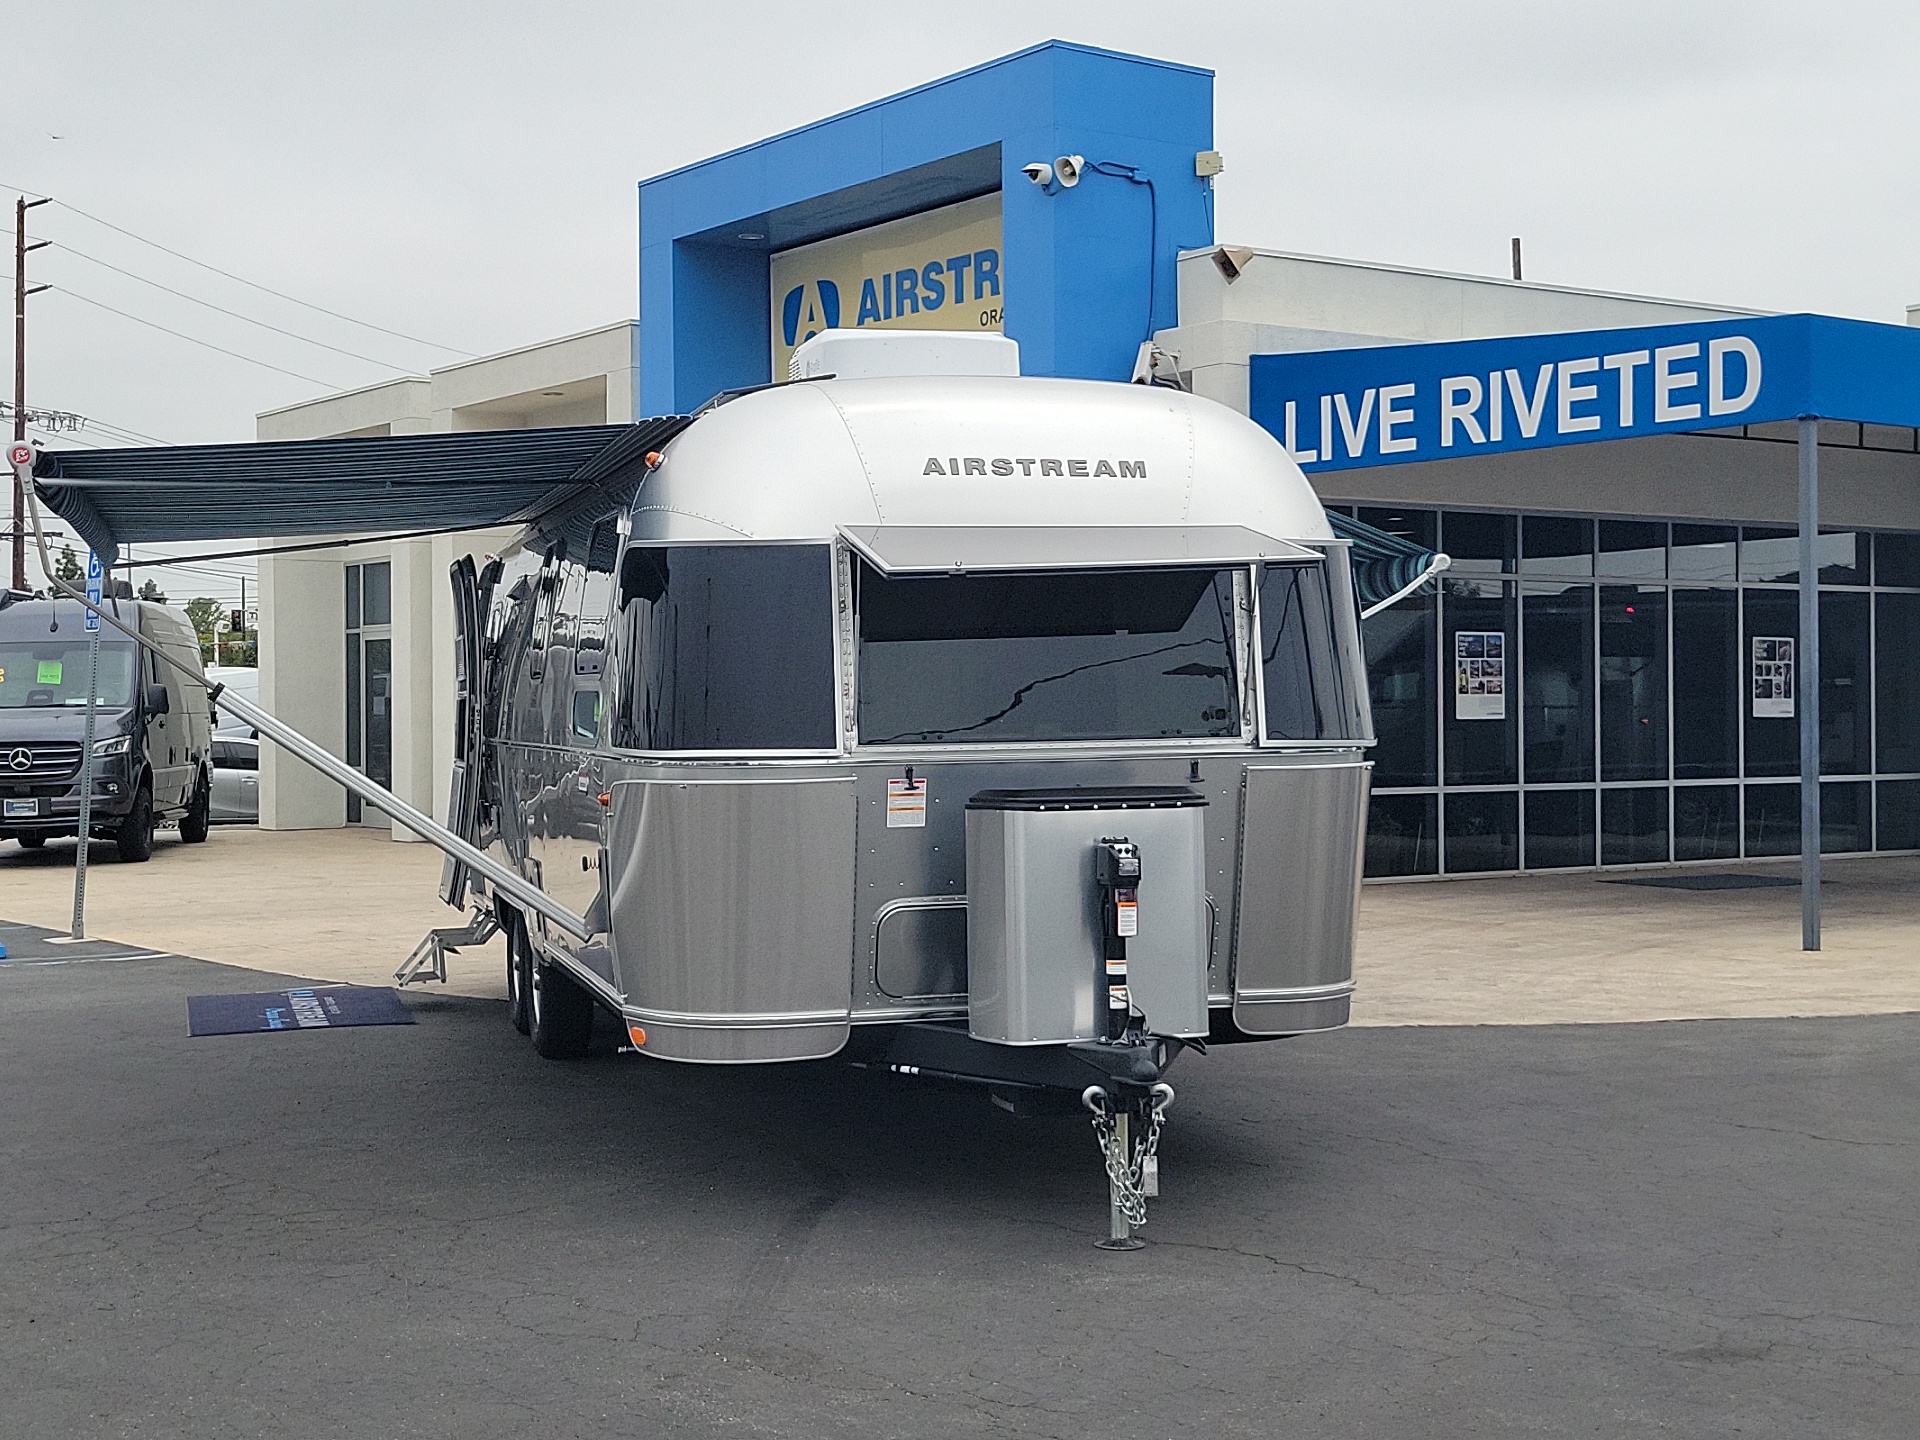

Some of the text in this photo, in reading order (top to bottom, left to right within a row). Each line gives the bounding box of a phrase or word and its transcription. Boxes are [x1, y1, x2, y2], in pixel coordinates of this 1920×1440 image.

[1285, 335, 1762, 464] LIVE RIVETED
[923, 457, 1147, 478] AIRSTREAM
